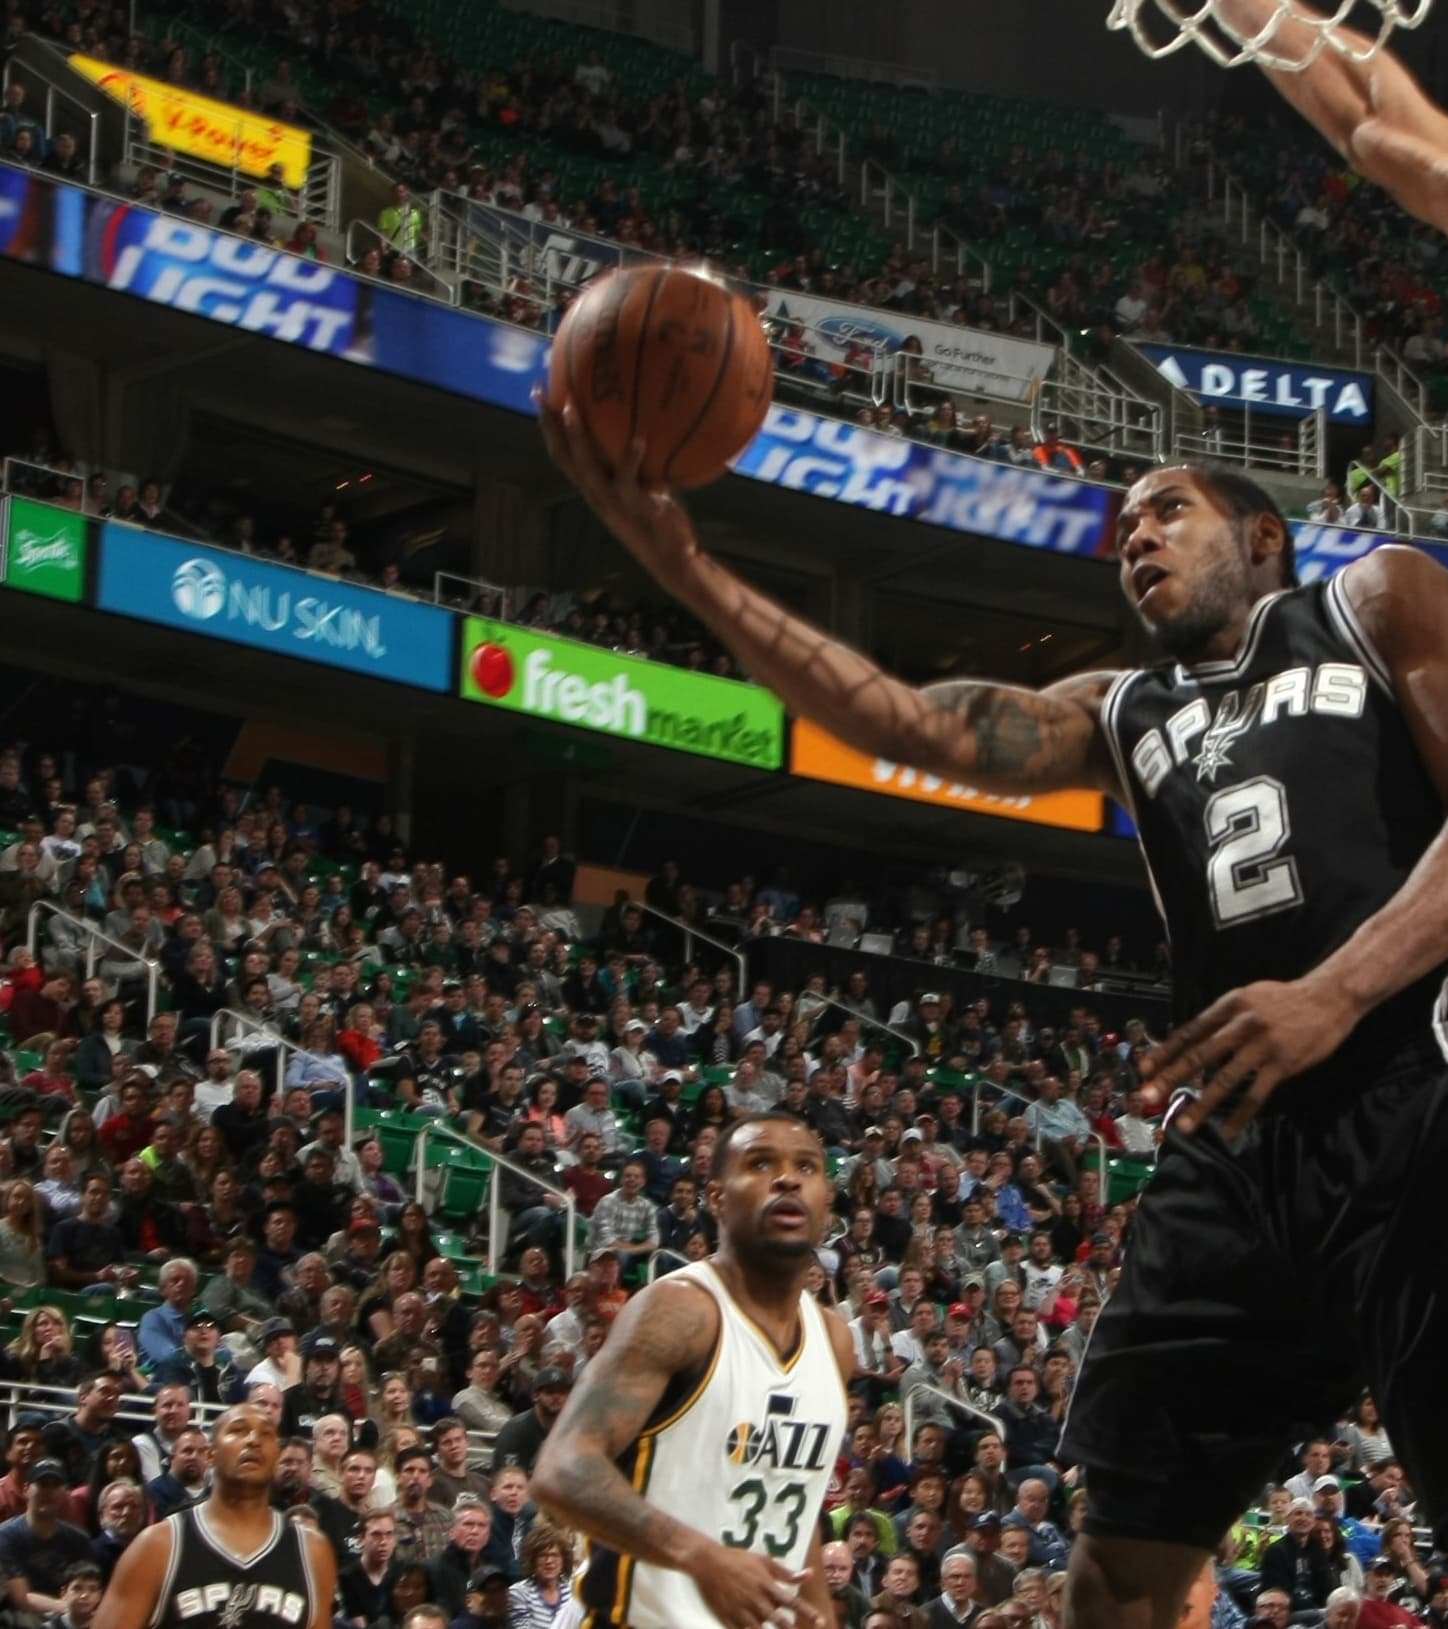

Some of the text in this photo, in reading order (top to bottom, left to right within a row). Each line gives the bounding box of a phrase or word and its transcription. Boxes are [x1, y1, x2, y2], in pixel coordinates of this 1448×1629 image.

[145, 211, 339, 294] BUD
[1200, 362, 1369, 418] DELTA
[752, 443, 917, 516] IGHT
[227, 578, 388, 660] NU SKIN
[522, 648, 774, 764] fresh market
[1131, 663, 1369, 798] SPURS
[1202, 773, 1305, 931] 2
[742, 1394, 833, 1472] JAZZ
[720, 1478, 809, 1559] 33
[175, 1581, 306, 1627] SPURS
